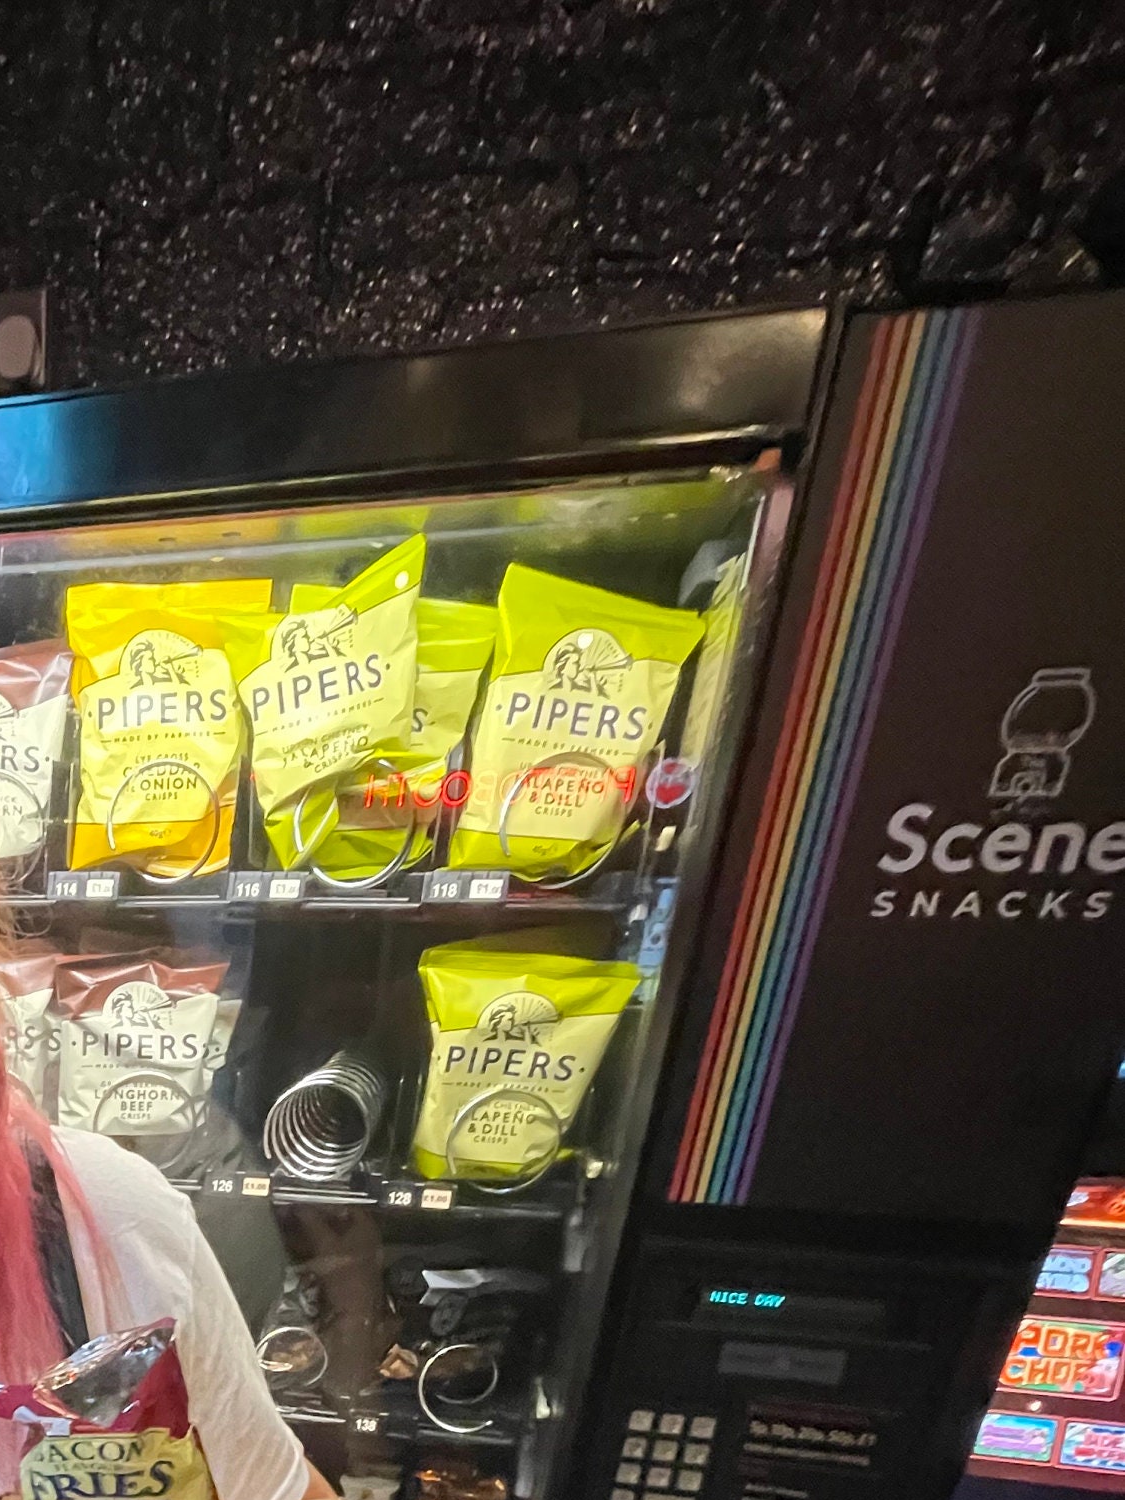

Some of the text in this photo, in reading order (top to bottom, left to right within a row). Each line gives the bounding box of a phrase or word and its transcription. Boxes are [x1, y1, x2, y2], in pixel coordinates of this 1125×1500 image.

[252, 653, 382, 722] PIPERS
[98, 689, 227, 731] PIPERS
[505, 692, 648, 741] PIPERS
[140, 776, 197, 791] ONION
[145, 792, 178, 802] CRISPS
[528, 791, 585, 808] & DILL
[534, 805, 574, 818] CRISPS
[877, 802, 1125, 874] Scene
[56, 882, 77, 896] 114
[236, 882, 260, 897] 116
[432, 883, 458, 898] 118
[870, 889, 1114, 919] SNACKS
[82, 1030, 198, 1060] PIPERS
[444, 1045, 577, 1082] PIPERS
[120, 1101, 153, 1112] BEEF
[467, 1123, 518, 1137] & DILL
[473, 1135, 508, 1145] CRISPS
[212, 1179, 234, 1193] 126
[388, 1191, 412, 1206] 128
[709, 1290, 786, 1308] NICE DAY
